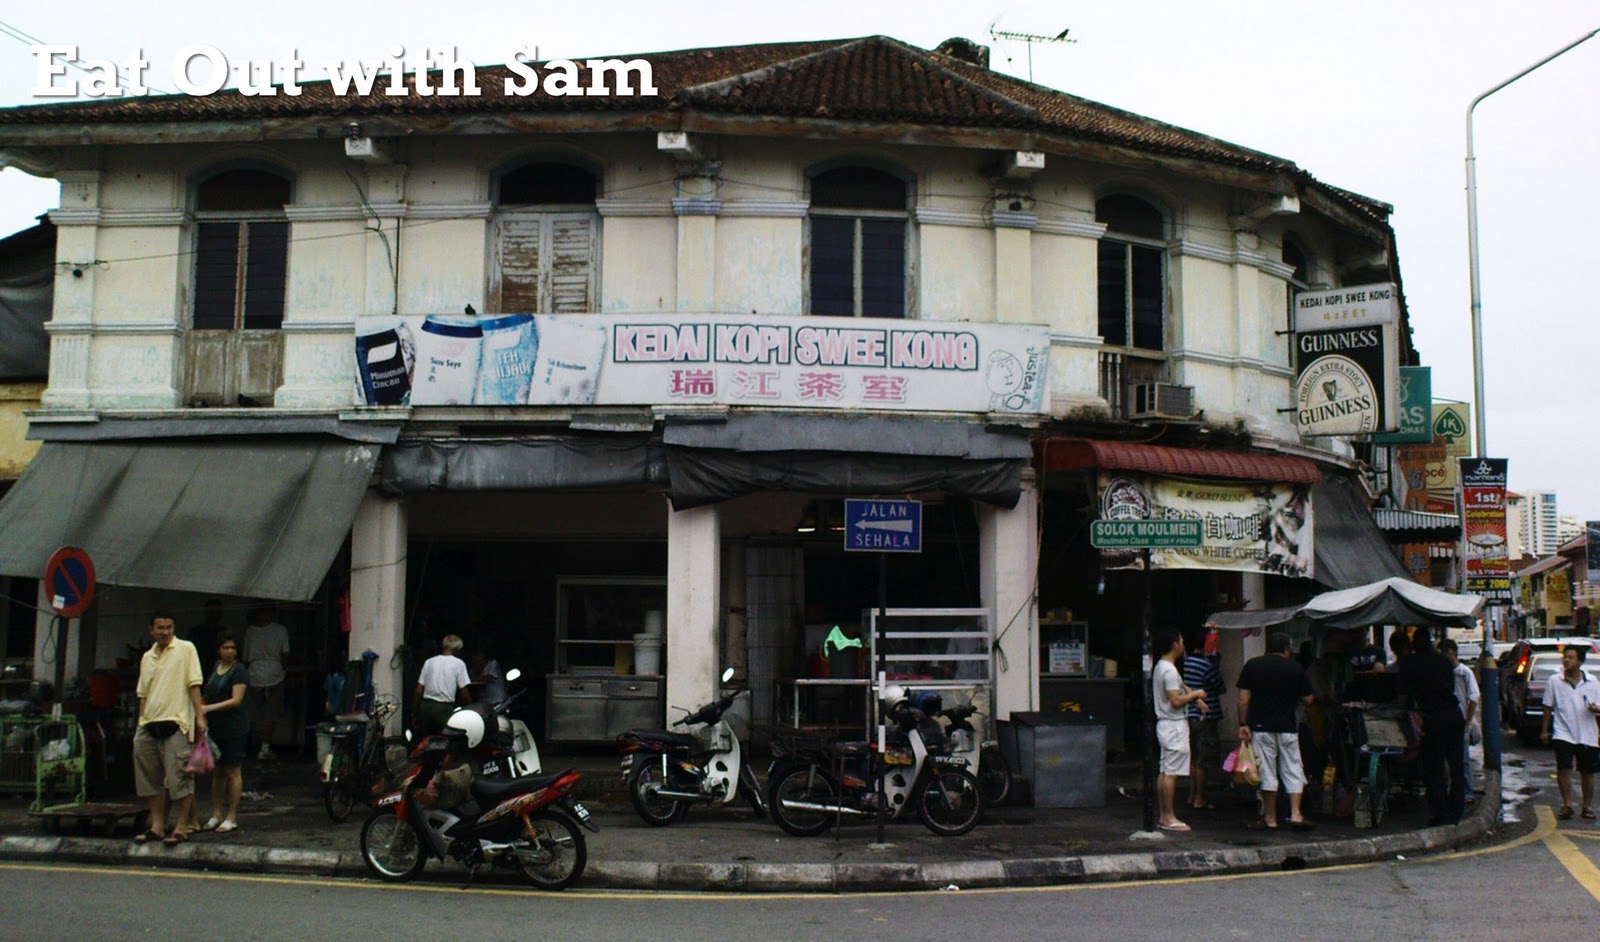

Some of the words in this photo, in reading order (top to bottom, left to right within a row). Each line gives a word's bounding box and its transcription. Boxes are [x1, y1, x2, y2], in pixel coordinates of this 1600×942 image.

[1301, 299, 1323, 308] KEDAI
[1325, 294, 1343, 305] KOPI
[1346, 292, 1366, 303] SWEE
[1369, 290, 1390, 300] KONG
[613, 324, 709, 362] KEDAI
[714, 324, 791, 364] KOPI
[795, 327, 886, 367] SWEE
[891, 331, 978, 370] KONG
[1300, 329, 1378, 353] GUINNESS
[1319, 362, 1344, 373] EXTRA
[1344, 366, 1365, 388] STOUT
[670, 370, 906, 401] 瑞江茶室
[1299, 394, 1371, 426] GUINNESS
[1475, 492, 1495, 503] 1st
[861, 504, 907, 517] JALAN
[1111, 505, 1131, 517] COFFEE
[1097, 523, 1134, 535] SOLOK
[1138, 523, 1197, 535] MOULMEIN
[855, 533, 910, 547] SEHALA
[1202, 546, 1232, 557] WHITE
[1233, 547, 1265, 559] COFFEE
